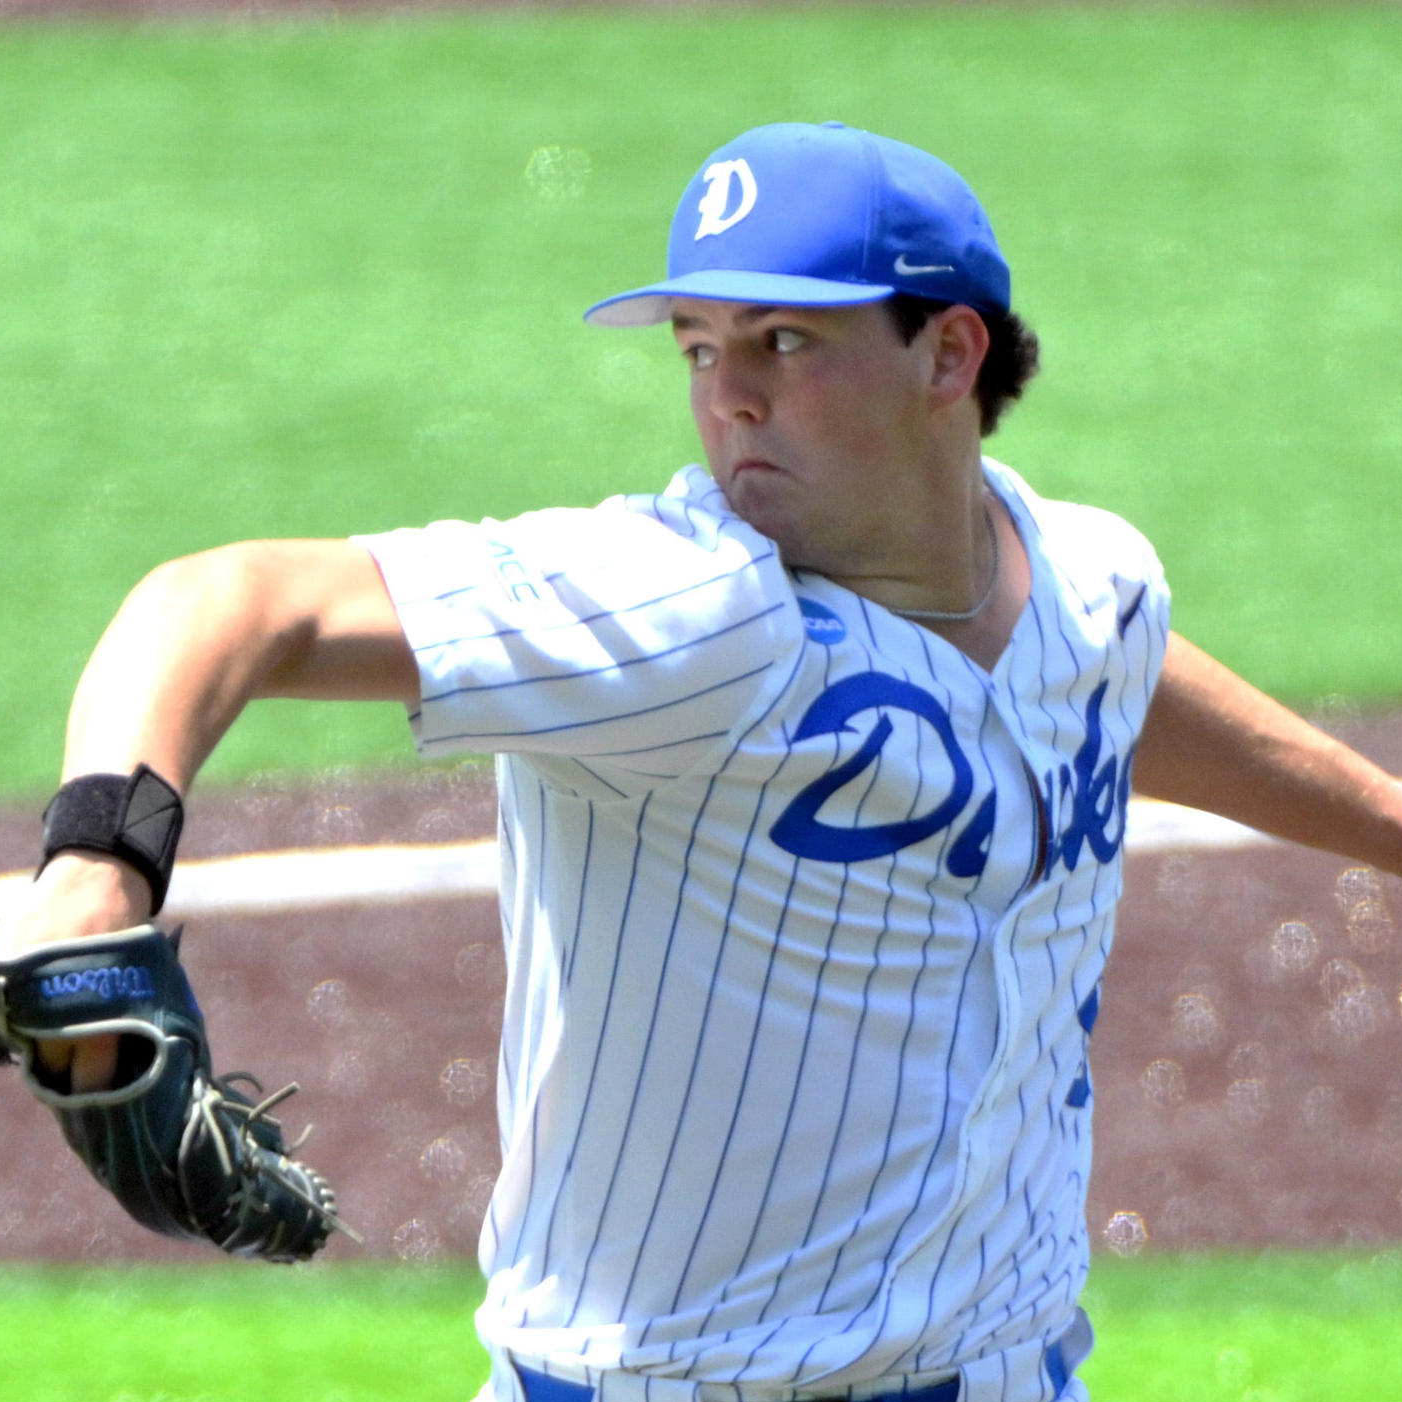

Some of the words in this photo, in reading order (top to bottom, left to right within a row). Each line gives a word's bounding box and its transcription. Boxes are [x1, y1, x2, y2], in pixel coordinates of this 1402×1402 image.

[694, 158, 757, 241] D
[803, 616, 843, 631] CAA
[41, 965, 155, 998] Wilson
